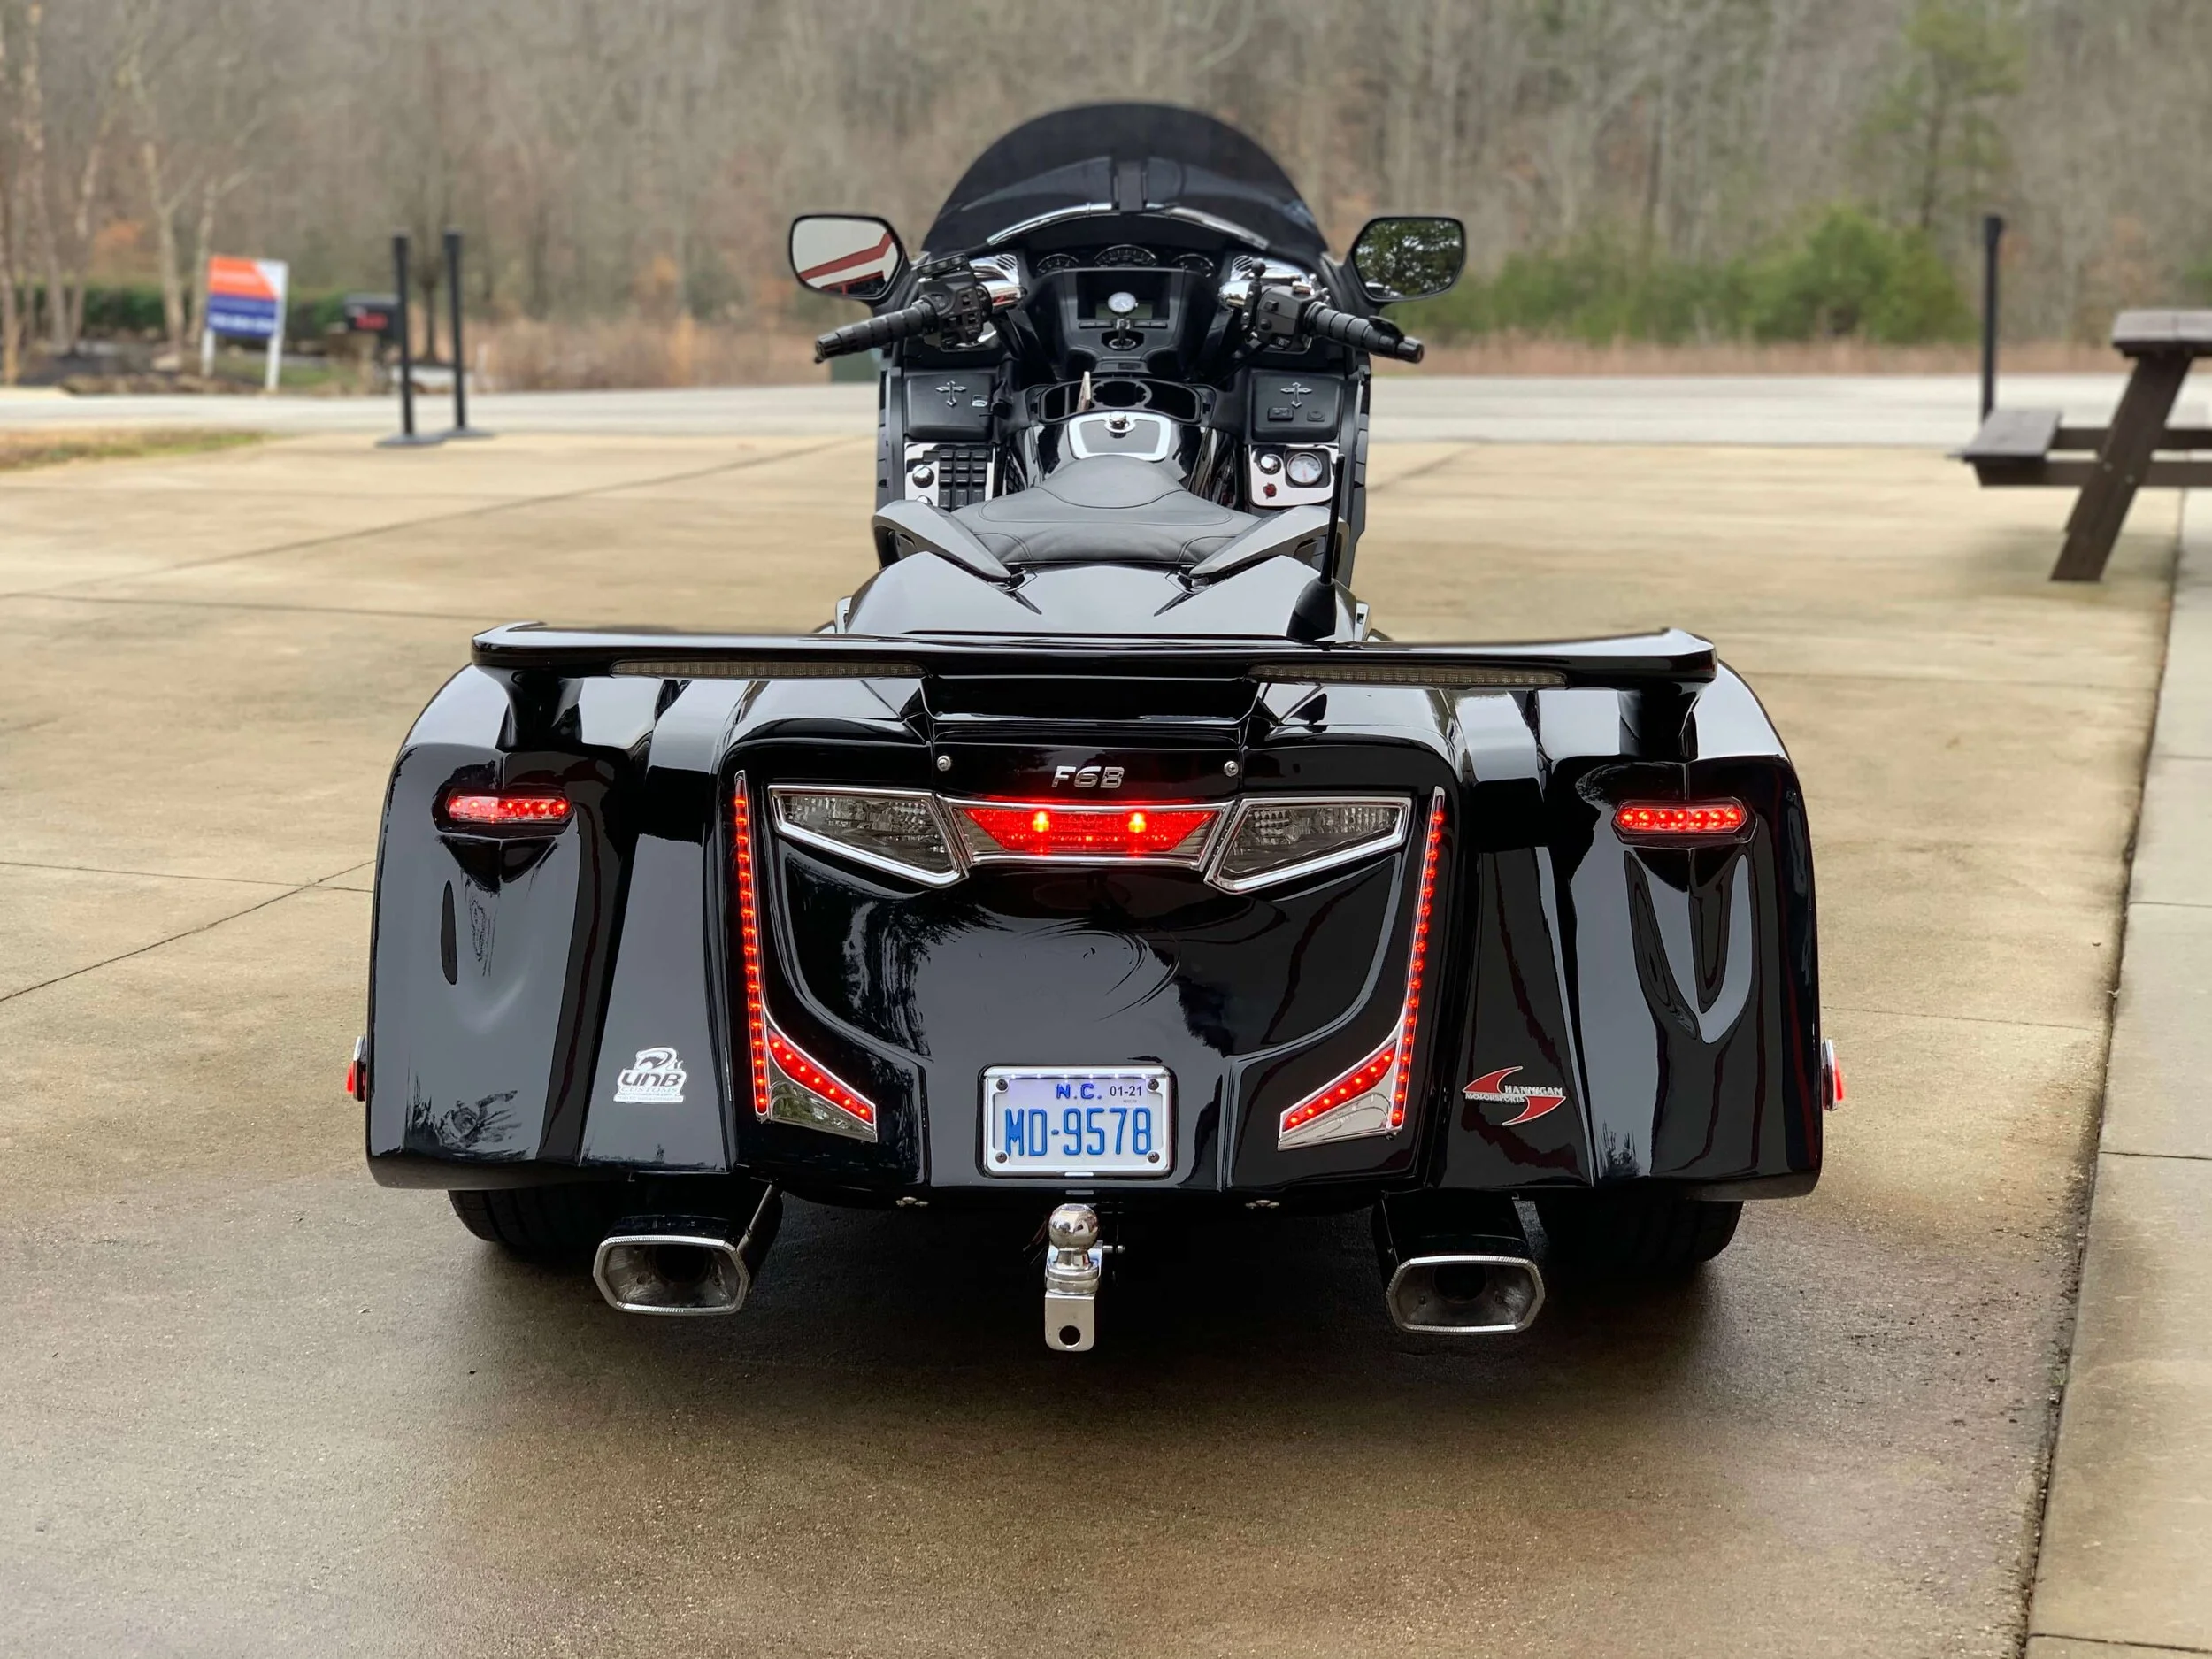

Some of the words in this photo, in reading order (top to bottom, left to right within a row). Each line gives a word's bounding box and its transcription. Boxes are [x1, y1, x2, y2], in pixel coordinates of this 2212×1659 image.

[1051, 765, 1125, 788] F6B
[1056, 1083, 1102, 1100] N.C.
[1110, 1085, 1142, 1097] 01-21
[1465, 1093, 1525, 1103] MOTORSPORTS
[1504, 1085, 1563, 1096] HANNIGAN
[1004, 1107, 1153, 1156] MD-9578
